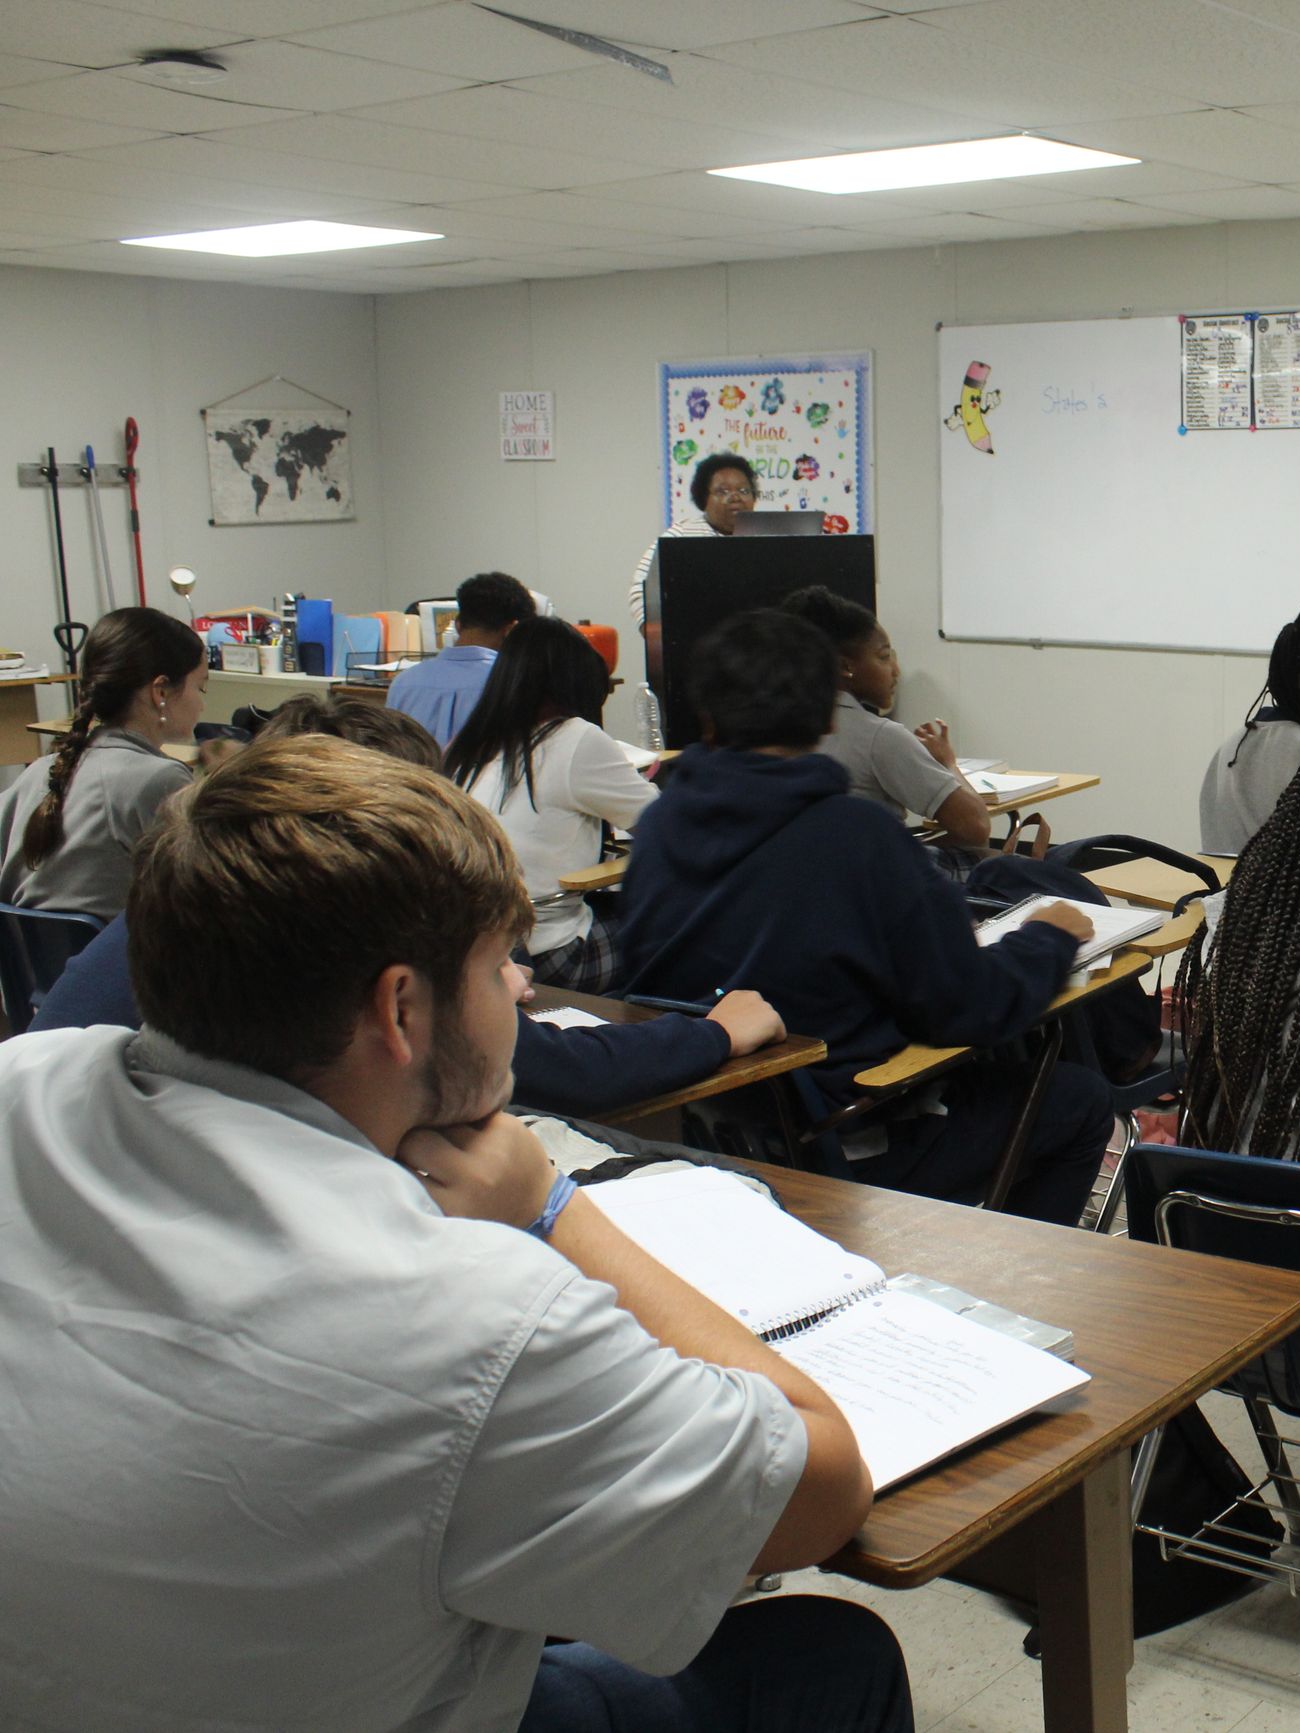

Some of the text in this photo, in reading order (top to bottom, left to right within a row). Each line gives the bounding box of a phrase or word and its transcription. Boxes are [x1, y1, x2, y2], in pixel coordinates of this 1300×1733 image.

[504, 394, 546, 411] HOME
[724, 418, 786, 448] THE future
[748, 456, 791, 479] RLD
